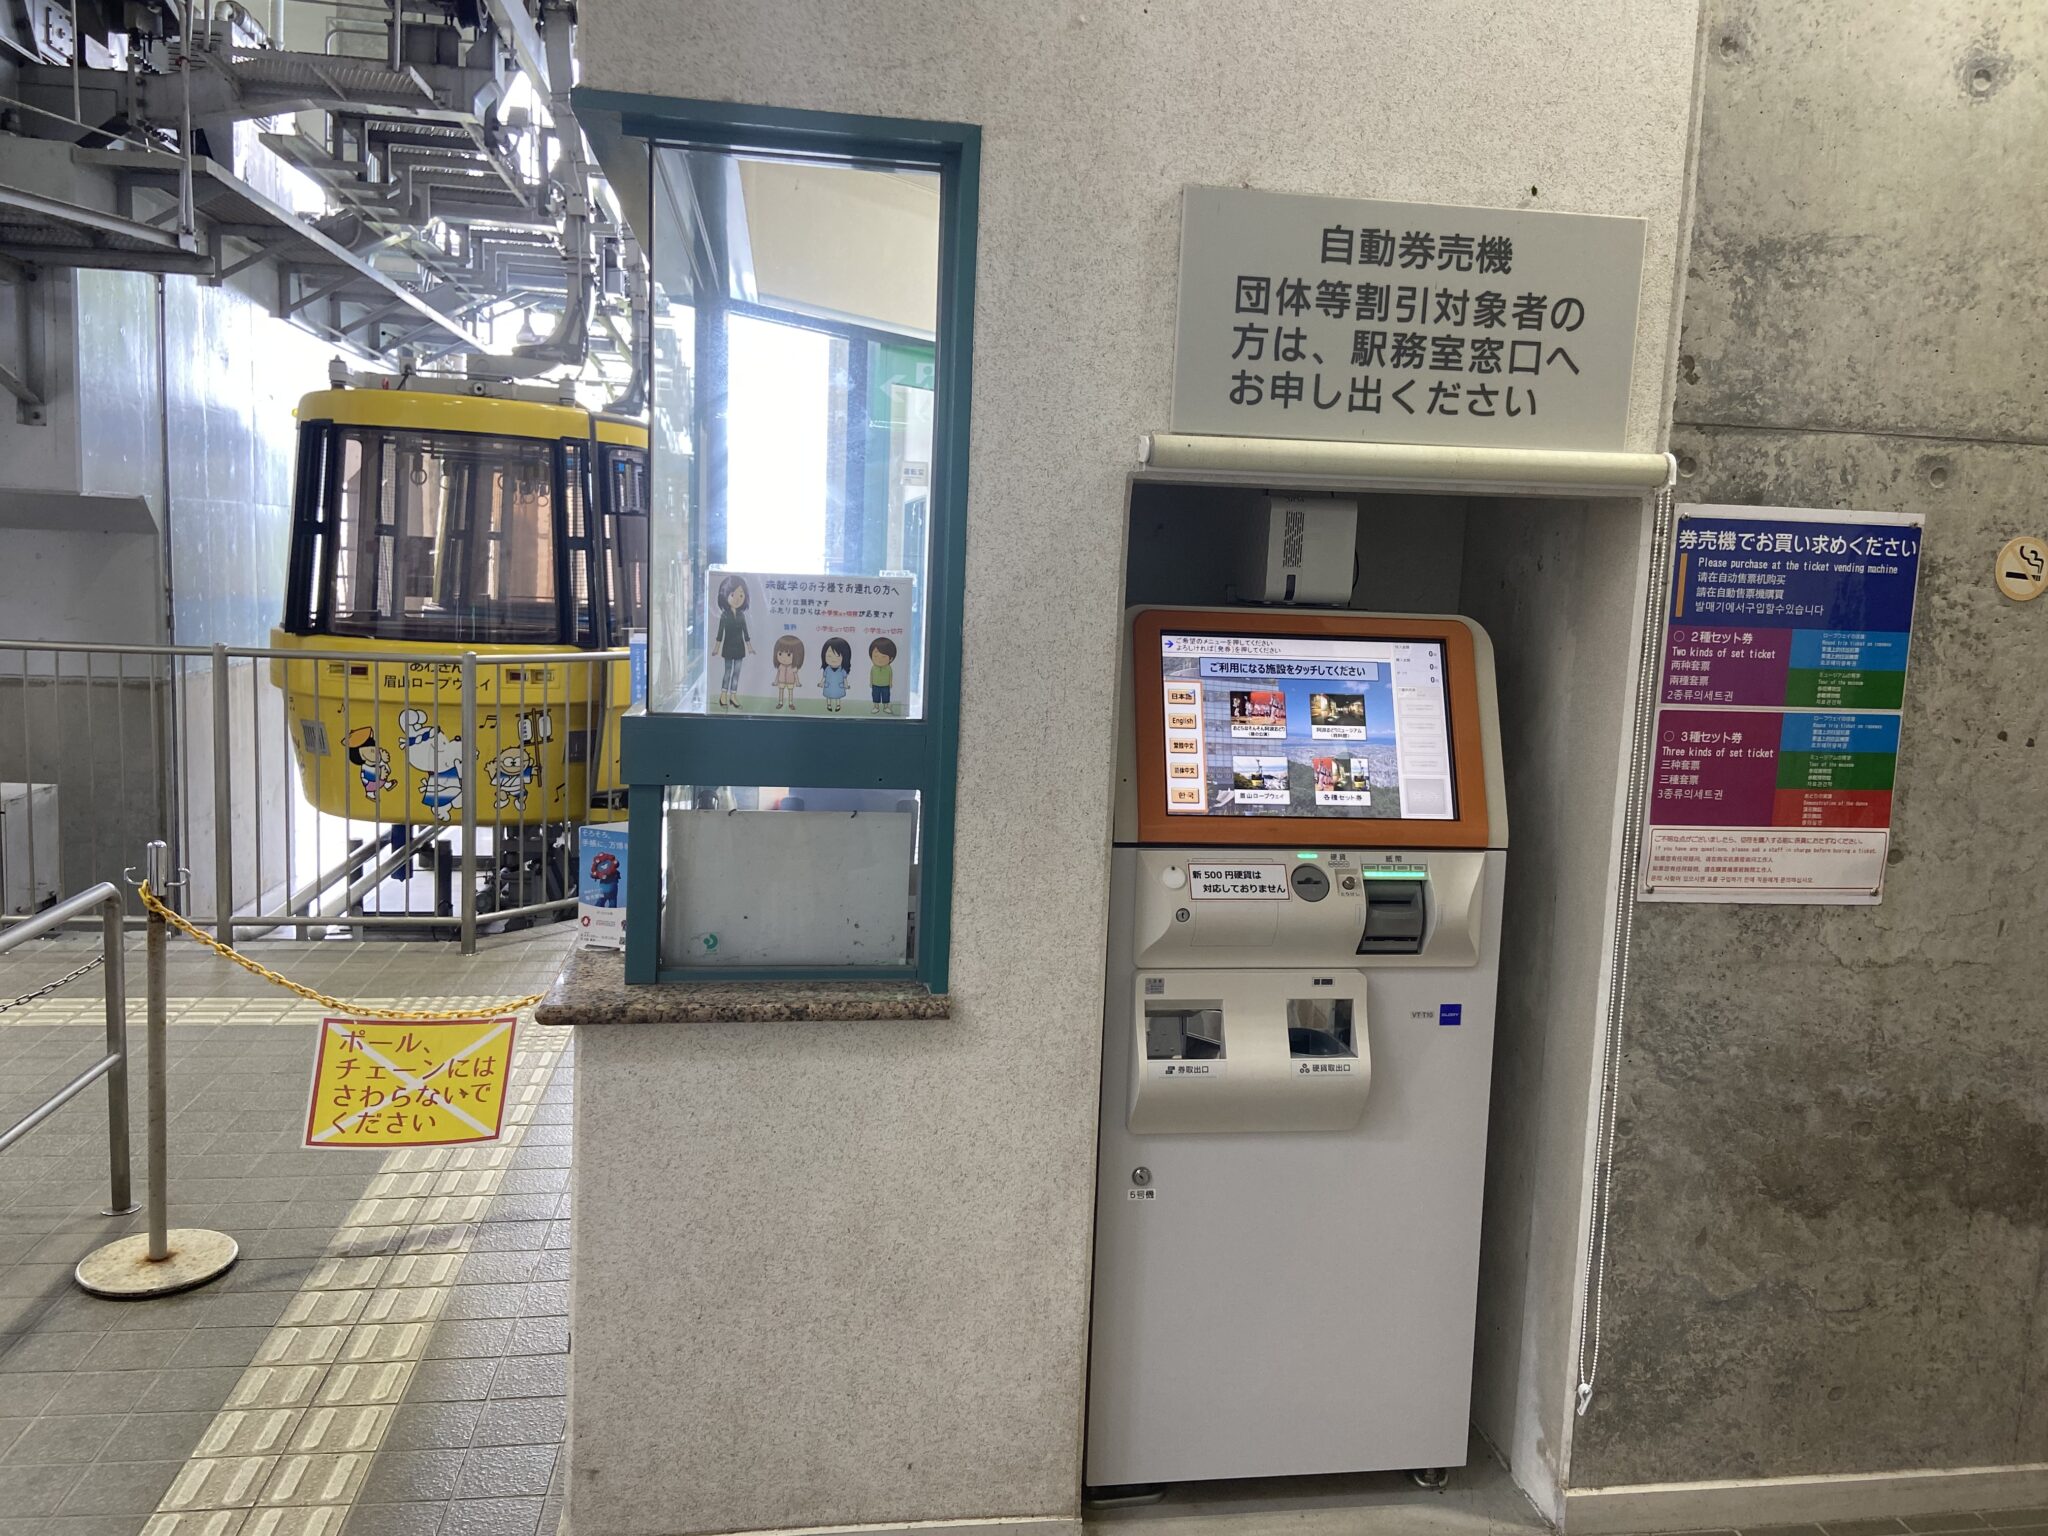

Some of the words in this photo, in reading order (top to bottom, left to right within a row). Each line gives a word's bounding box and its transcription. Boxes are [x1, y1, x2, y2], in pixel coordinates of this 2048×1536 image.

[1320, 224, 1513, 275] 自動券売機
[1234, 275, 1585, 333] 団体等割引対象者の
[1231, 323, 1581, 376] 方は、駅務室窓口へ
[1229, 369, 1537, 417] お申し出ください
[1679, 530, 1917, 557] 券売機でお買い求めください
[1698, 557, 1727, 567] Please
[1731, 559, 1768, 570] purchase
[1771, 561, 1781, 570] at
[1786, 560, 1799, 570] the
[1803, 561, 1829, 571] ticket
[1833, 563, 1865, 574] vending
[1867, 564, 1898, 574] machine
[1697, 572, 1786, 585] 请在自动售票机购买
[765, 580, 900, 597] 未就学のお子様をお連れの方へ
[1696, 587, 1784, 600] 請在自動售票機購買
[1695, 601, 1824, 616] 발매기에서구입할수있습니다
[1176, 638, 1273, 647] ご希望のメニューを押してください
[1672, 646, 1686, 657] Two
[1690, 647, 1713, 657] kinds
[1717, 647, 1726, 657] of
[1731, 649, 1744, 658] set
[1749, 649, 1776, 659] ticket
[1210, 662, 1366, 677] ご利用になる施設をタッチしてください
[1671, 660, 1710, 671] 两种套票
[384, 674, 491, 691] 眉山ロープウイ
[1667, 690, 1733, 702] 2종류의세트권
[1172, 717, 1194, 725] English
[1662, 746, 1685, 757] Three
[1688, 747, 1712, 757] kinds
[1716, 748, 1725, 757] of
[1729, 748, 1743, 758] set
[1747, 748, 1774, 758] ticket
[1661, 760, 1701, 771] 三种套票
[1659, 774, 1699, 785] 三種套票
[1323, 793, 1363, 801] 各種セット券
[1657, 789, 1723, 801] 3종류의세트권
[1203, 884, 1286, 893] 対応しておりません
[339, 1029, 430, 1054] ポール、
[336, 1056, 496, 1080] チェーンには
[1178, 1065, 1209, 1074] 券取出口
[1312, 1064, 1351, 1072] 硬貨取出口
[333, 1083, 491, 1108] さわらないで
[332, 1111, 436, 1134] ください
